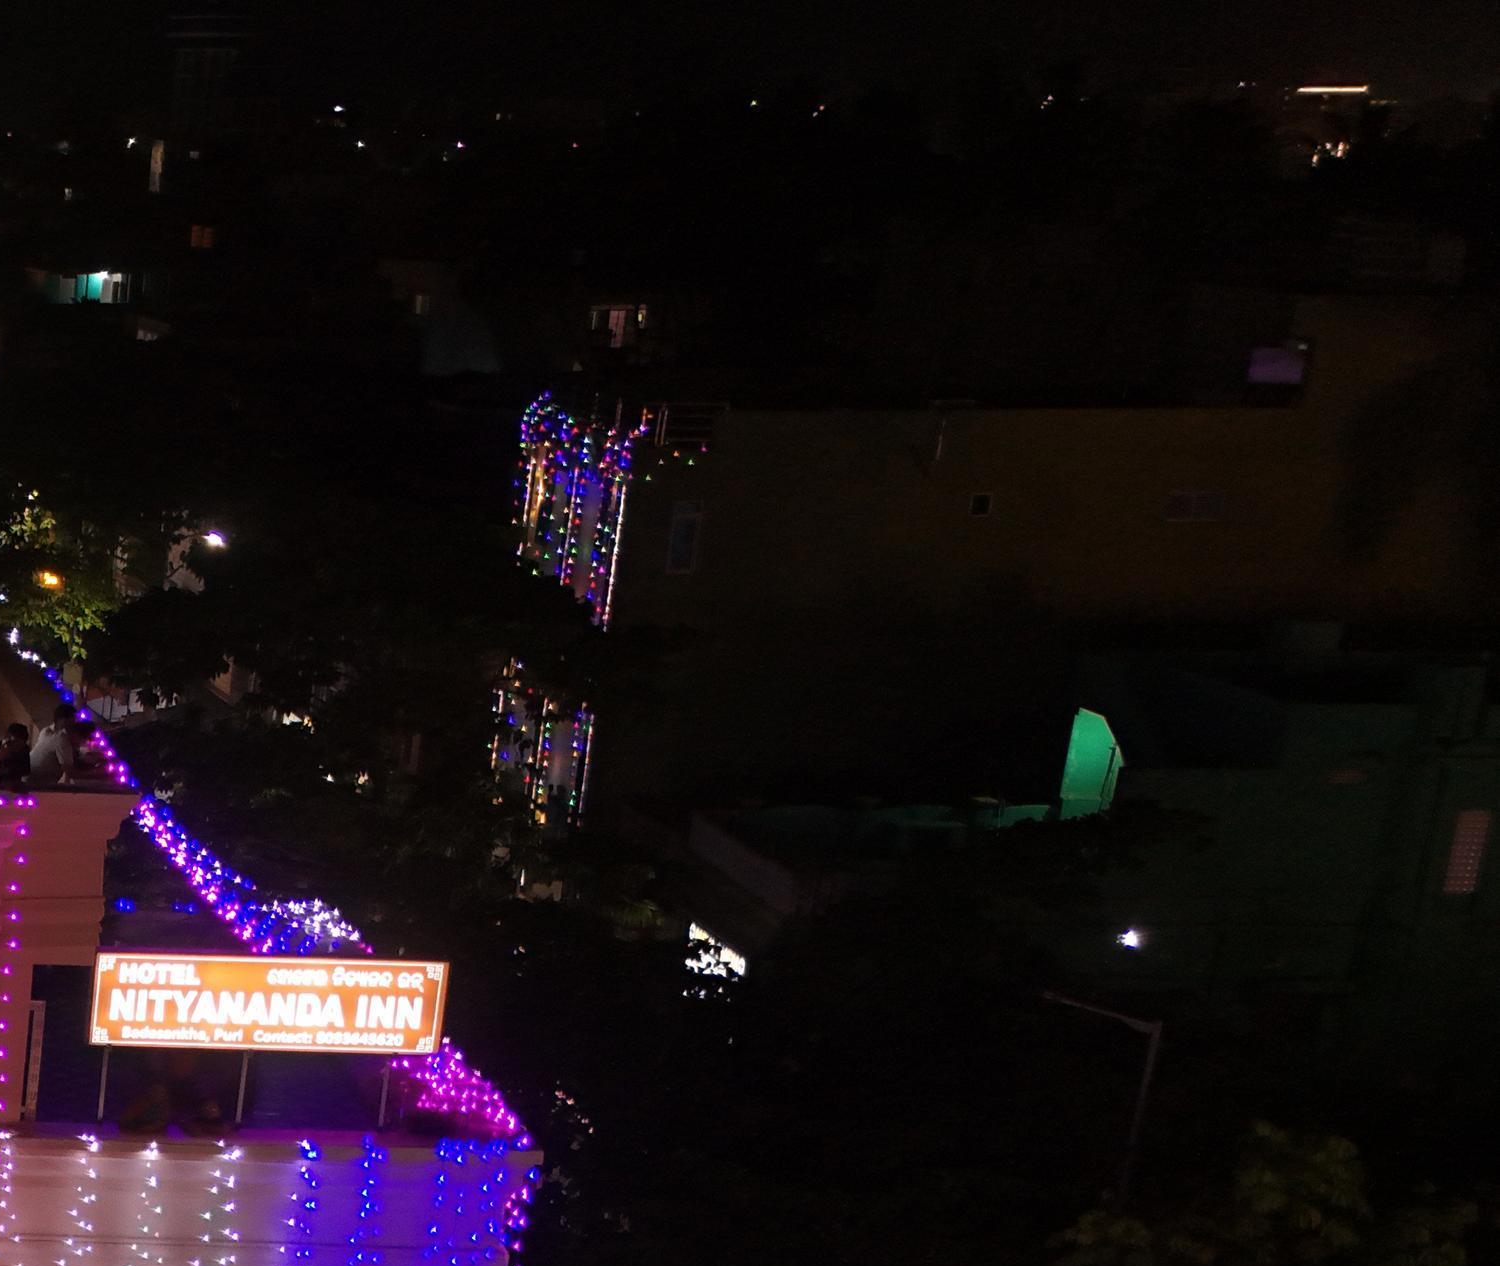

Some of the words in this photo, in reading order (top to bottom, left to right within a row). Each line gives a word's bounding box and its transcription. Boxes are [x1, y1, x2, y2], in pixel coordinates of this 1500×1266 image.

[118, 962, 201, 987] HOTEL
[108, 988, 345, 1028] NITYANANDA
[354, 994, 425, 1031] INN
[212, 1028, 244, 1043] Puri
[252, 1029, 314, 1046] Contact:
